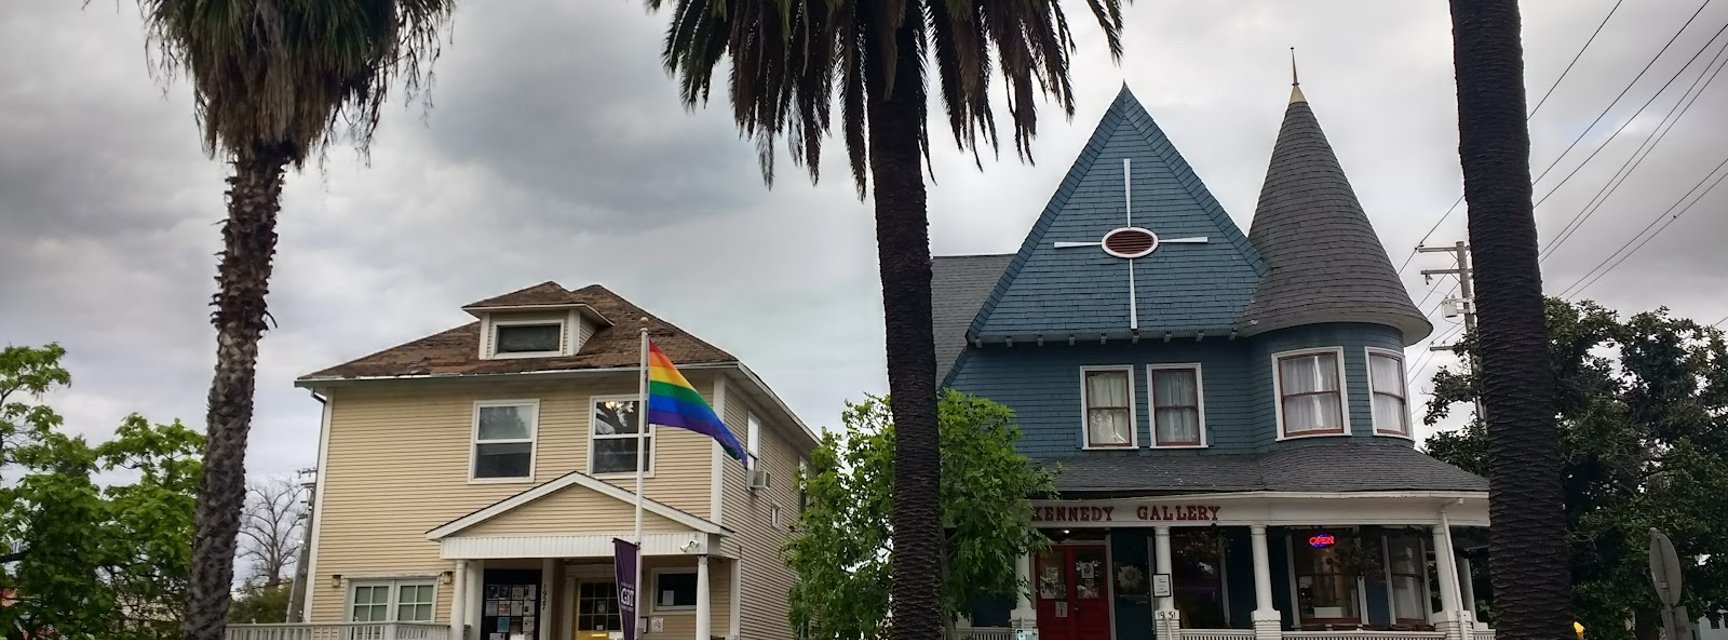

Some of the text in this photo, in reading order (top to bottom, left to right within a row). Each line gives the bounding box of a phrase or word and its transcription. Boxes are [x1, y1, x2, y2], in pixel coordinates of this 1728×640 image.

[1031, 505, 1221, 522] KENNEDY GALLERY
[1309, 535, 1335, 545] OPEN
